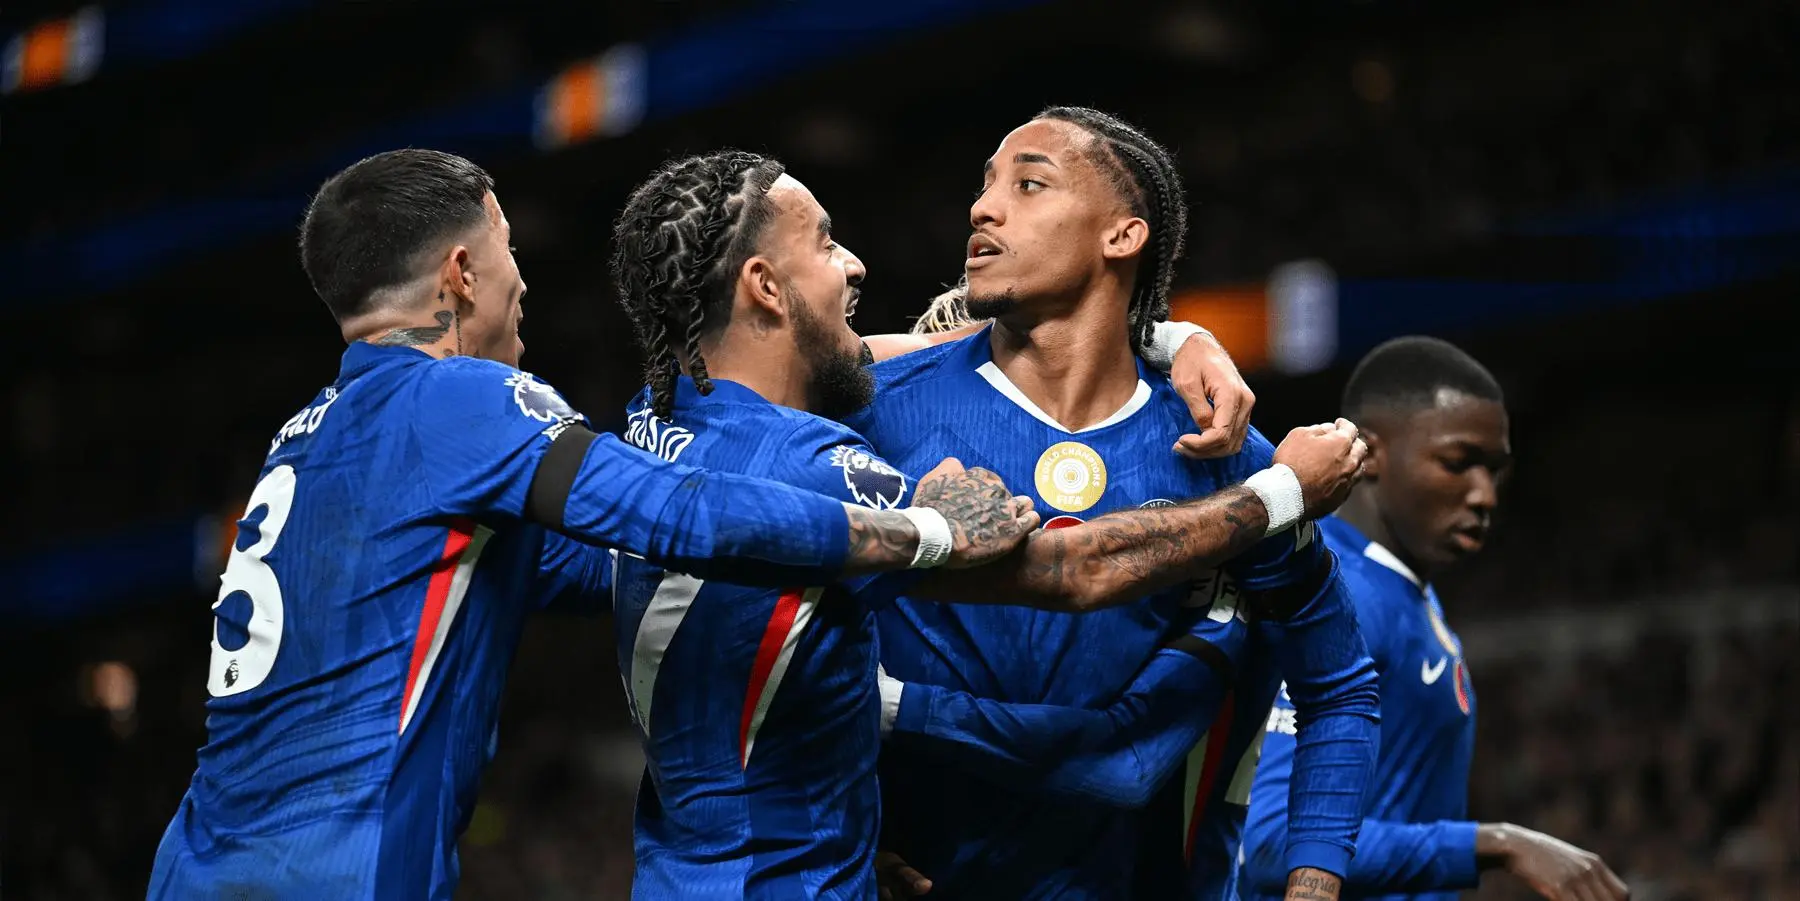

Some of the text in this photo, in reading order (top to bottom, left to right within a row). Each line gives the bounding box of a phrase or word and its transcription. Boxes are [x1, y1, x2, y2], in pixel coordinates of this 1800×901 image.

[1040, 447, 1101, 487] WORLD CHAMPIONS
[1057, 495, 1083, 506] FIFA
[207, 465, 297, 698] 8
